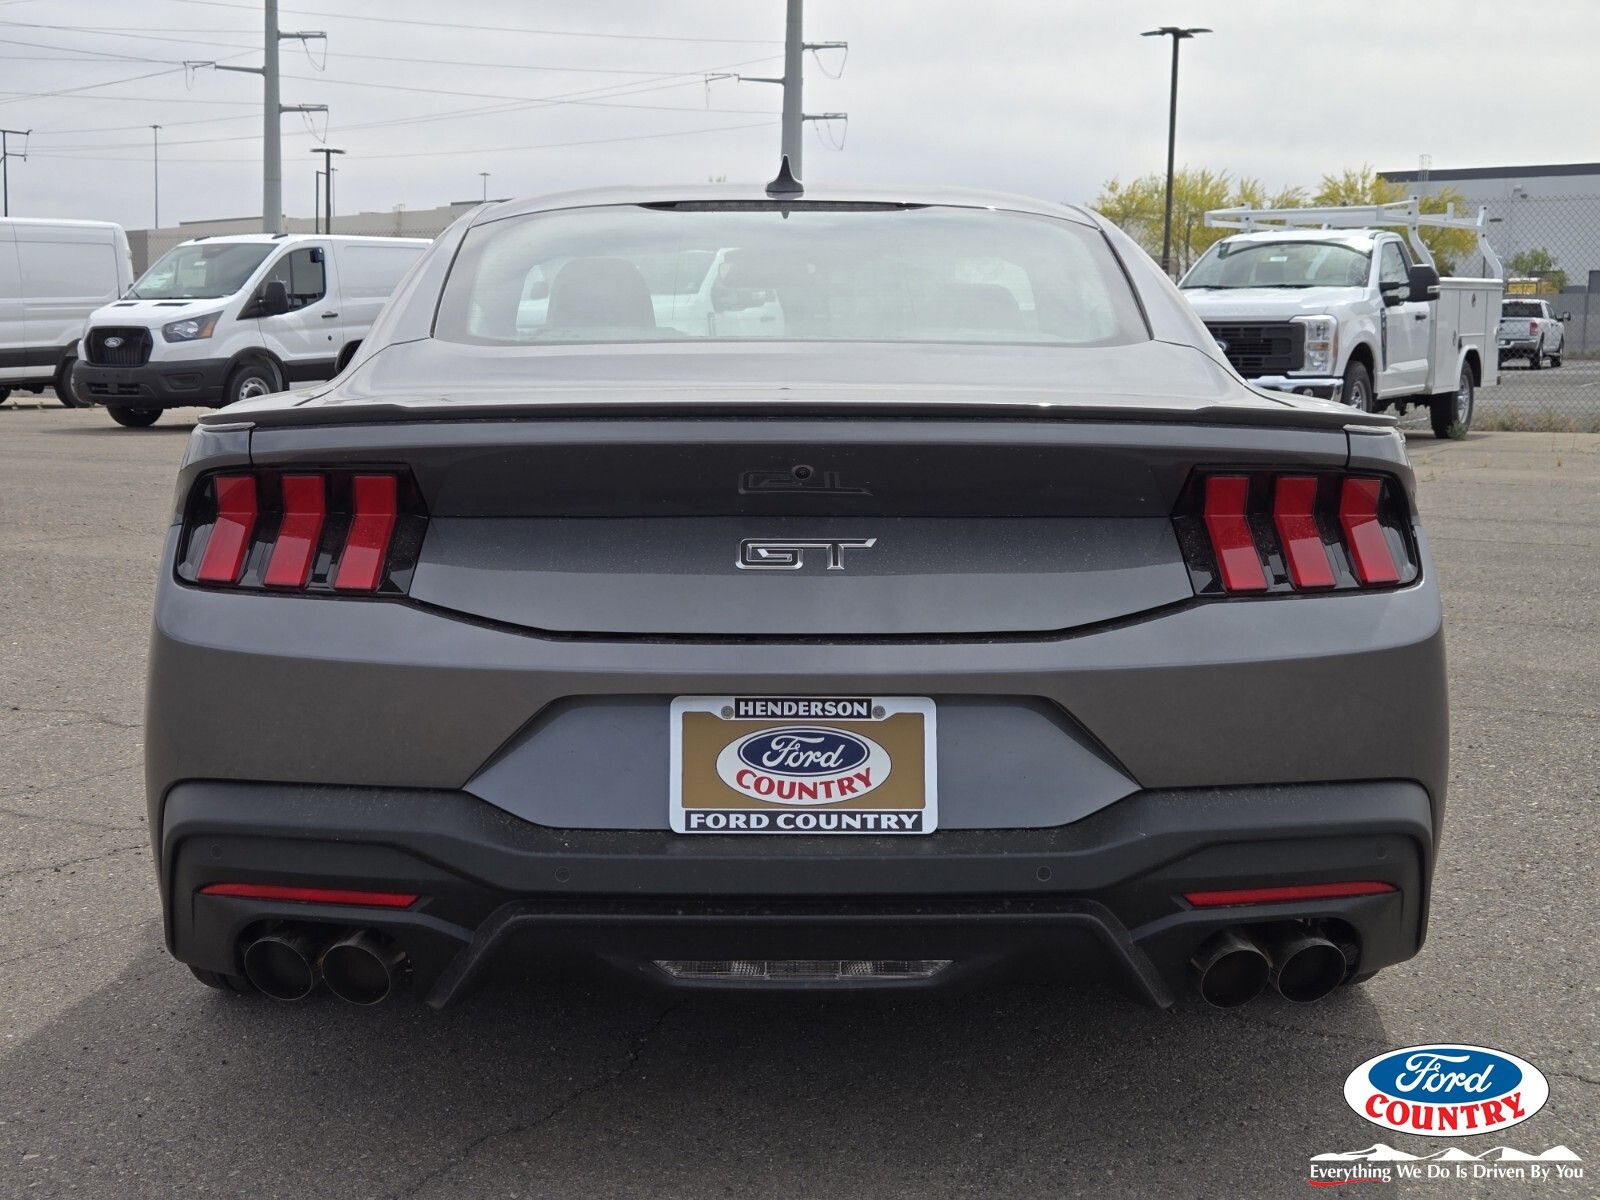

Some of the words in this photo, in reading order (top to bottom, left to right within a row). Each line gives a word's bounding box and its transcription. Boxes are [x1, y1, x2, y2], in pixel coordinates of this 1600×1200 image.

[735, 538, 877, 570] GT
[739, 701, 868, 717] HENDERSON
[762, 735, 846, 769] Ford
[736, 767, 872, 800] COUNTRY
[690, 813, 770, 829] FORD
[776, 813, 919, 830] COUNTRY
